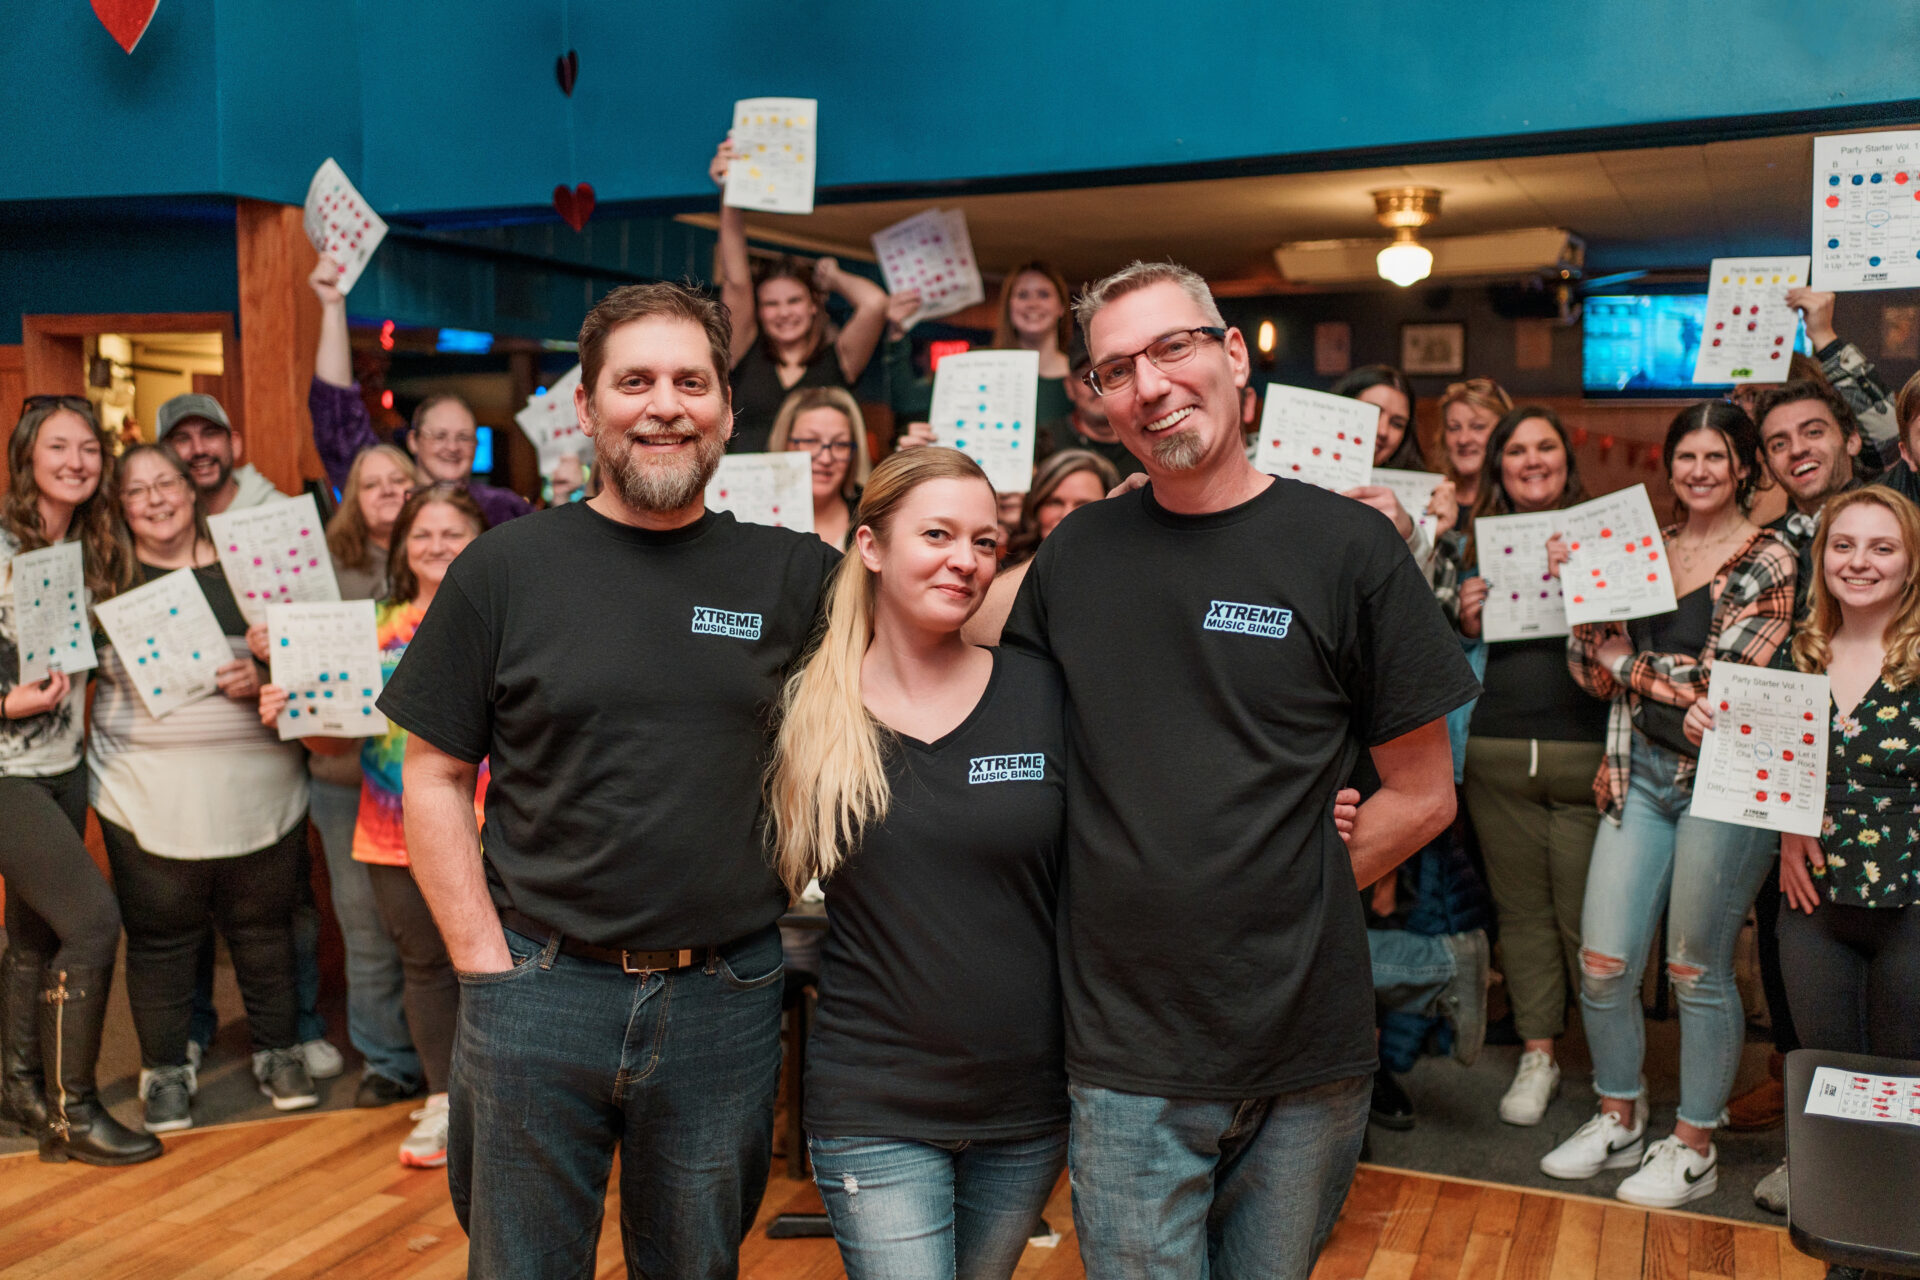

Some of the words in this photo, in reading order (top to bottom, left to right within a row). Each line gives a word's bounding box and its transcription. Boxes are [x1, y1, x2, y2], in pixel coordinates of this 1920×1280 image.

[1840, 146, 1863, 154] Party
[1865, 144, 1893, 152] Starter
[1832, 160, 1838, 168] B
[695, 608, 760, 628] XTREME
[1209, 603, 1290, 626] XTREME
[694, 623, 727, 634] MUSIC
[729, 627, 759, 638] BINGO
[1206, 618, 1245, 630] MUSIC
[1247, 623, 1285, 636] BINGO
[1732, 674, 1751, 685] Party
[1753, 678, 1779, 688] Starter
[1763, 692, 1770, 700] N
[1784, 695, 1792, 703] G
[1805, 698, 1813, 706] O
[972, 755, 1042, 773] XTREME
[971, 771, 1008, 782] MUSIC
[1010, 770, 1042, 779] BINGO
